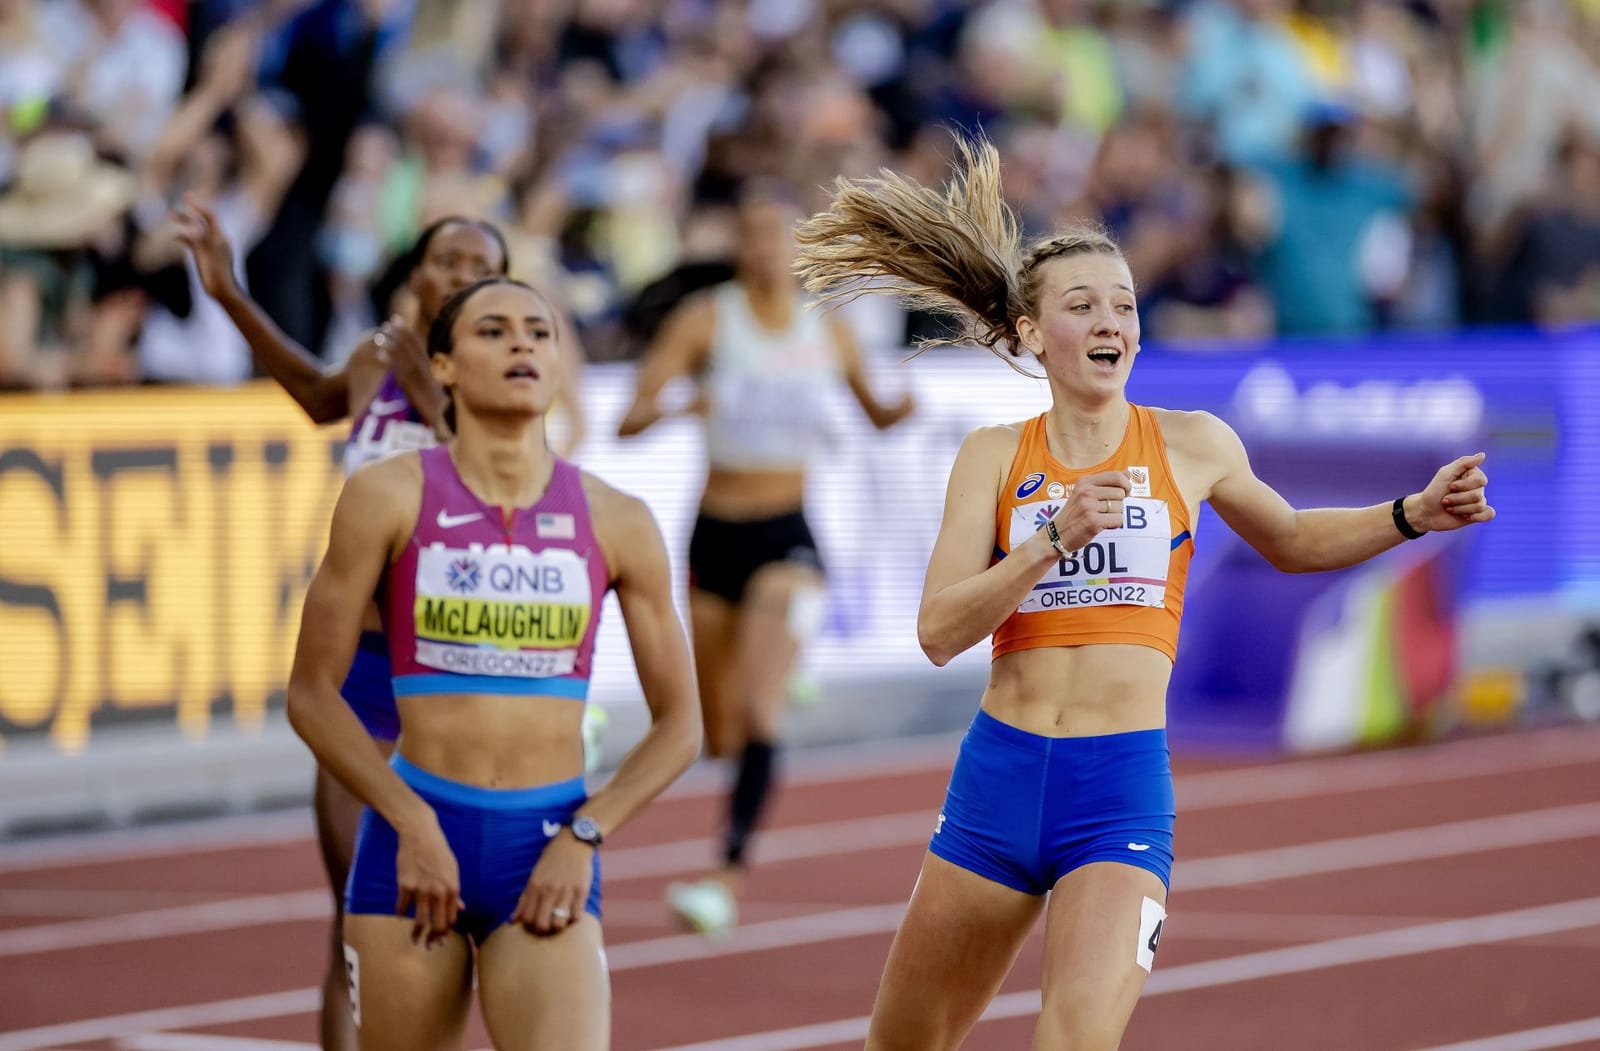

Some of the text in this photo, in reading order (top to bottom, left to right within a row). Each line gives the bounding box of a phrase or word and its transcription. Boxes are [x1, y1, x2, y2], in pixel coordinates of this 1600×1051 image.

[1058, 542, 1128, 577] BOL
[488, 563, 565, 593] QNB
[1041, 586, 1146, 608] OREGON22
[424, 599, 582, 640] McLAUGHLIN
